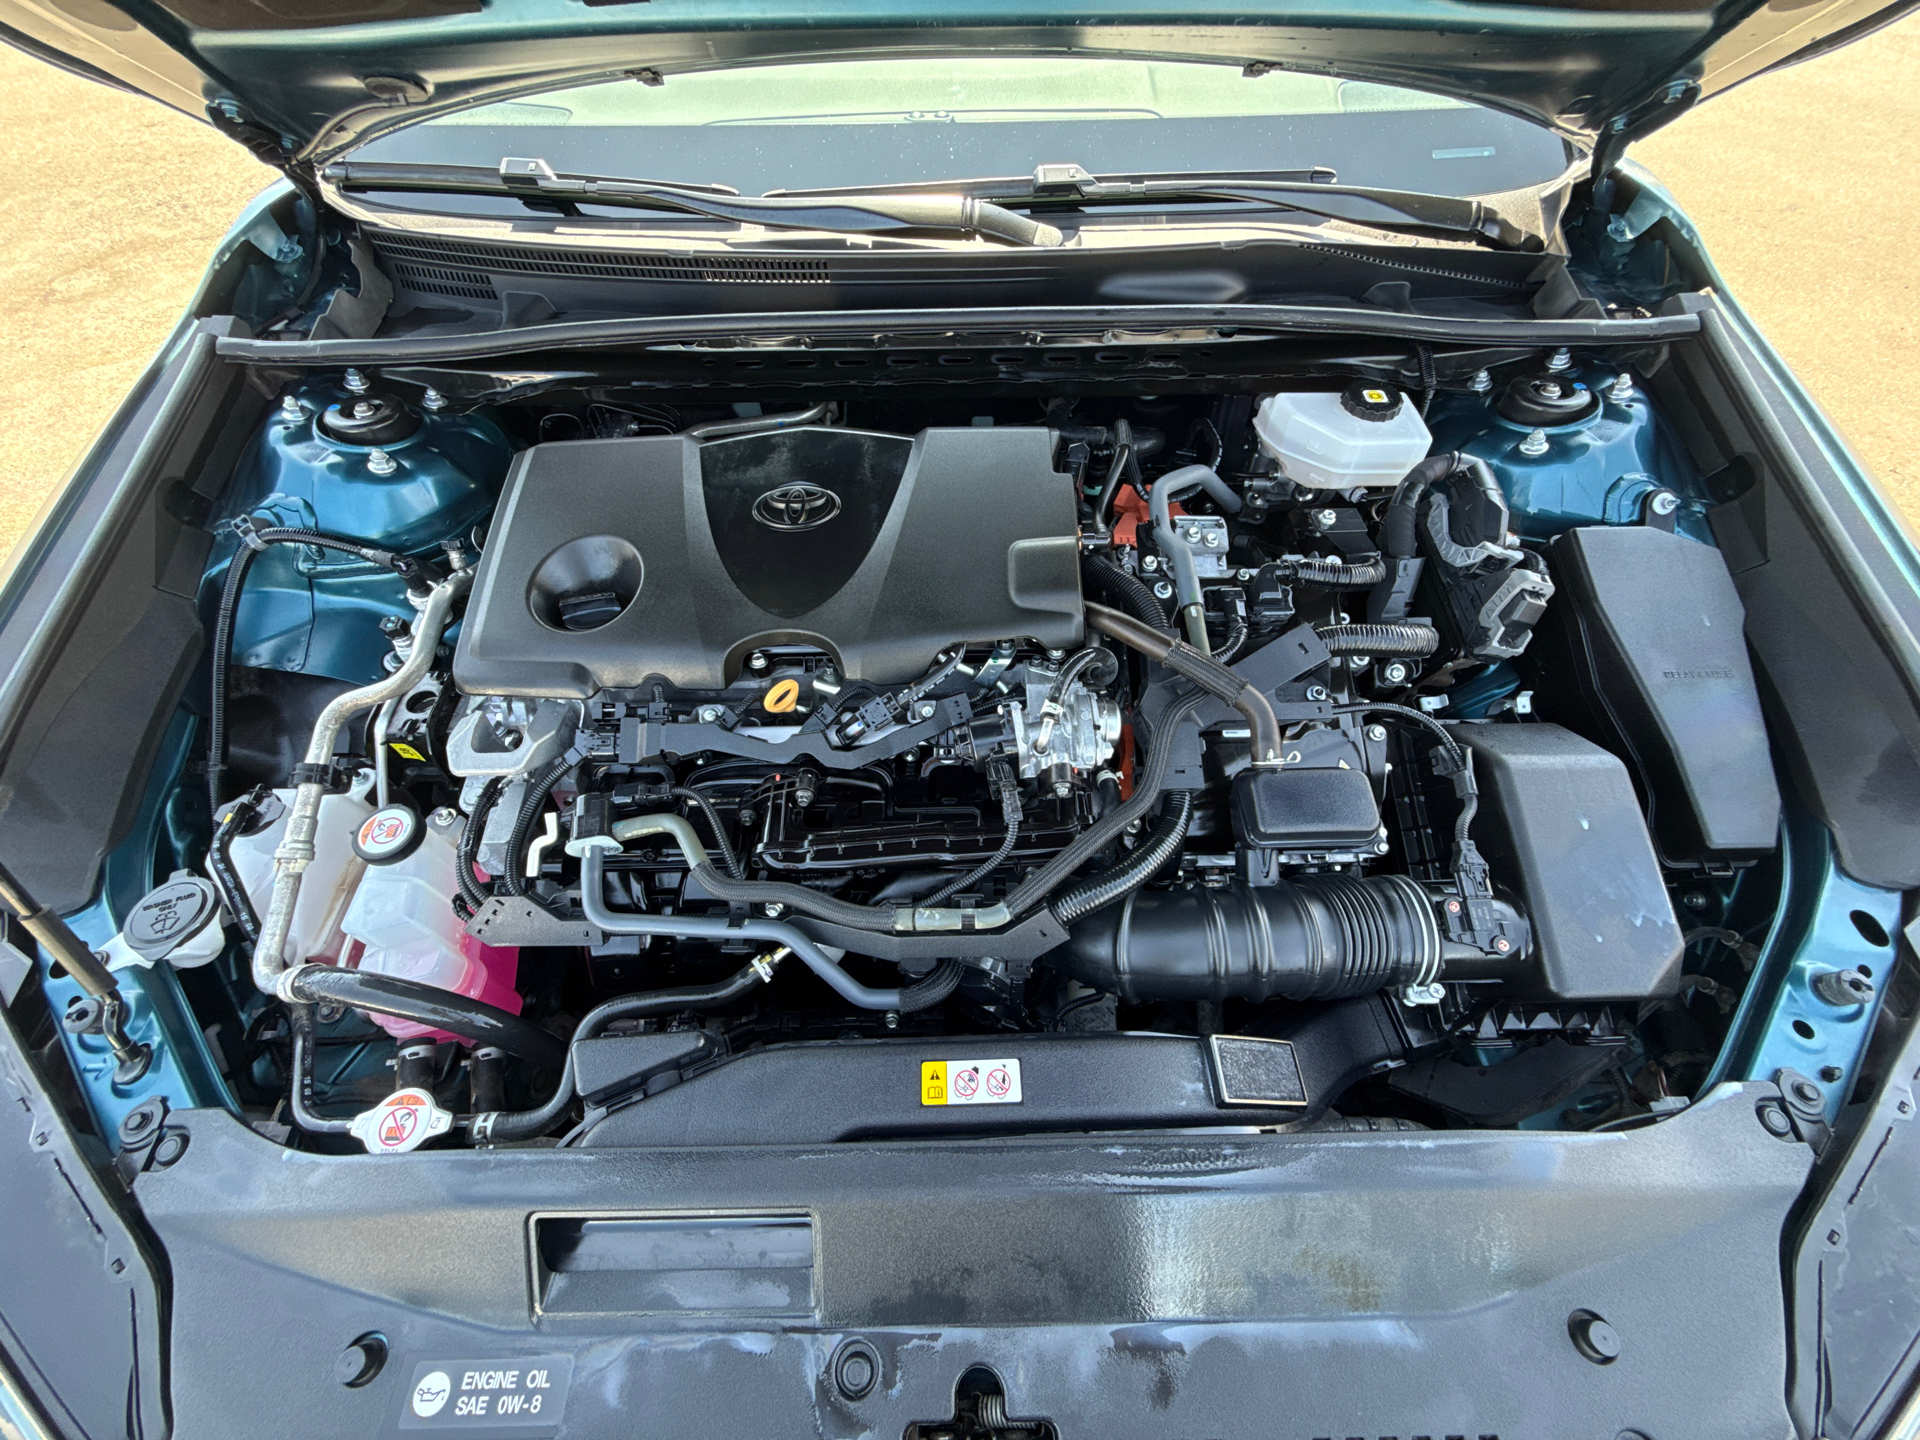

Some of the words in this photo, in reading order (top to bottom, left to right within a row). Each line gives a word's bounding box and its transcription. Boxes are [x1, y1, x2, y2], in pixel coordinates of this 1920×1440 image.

[1663, 670, 1695, 679] RELAY
[1706, 670, 1733, 678] FUSE
[461, 1370, 519, 1390] ENGINE
[526, 1369, 551, 1388] OIL
[455, 1396, 489, 1415] SAE
[497, 1394, 543, 1414] 0W-8
